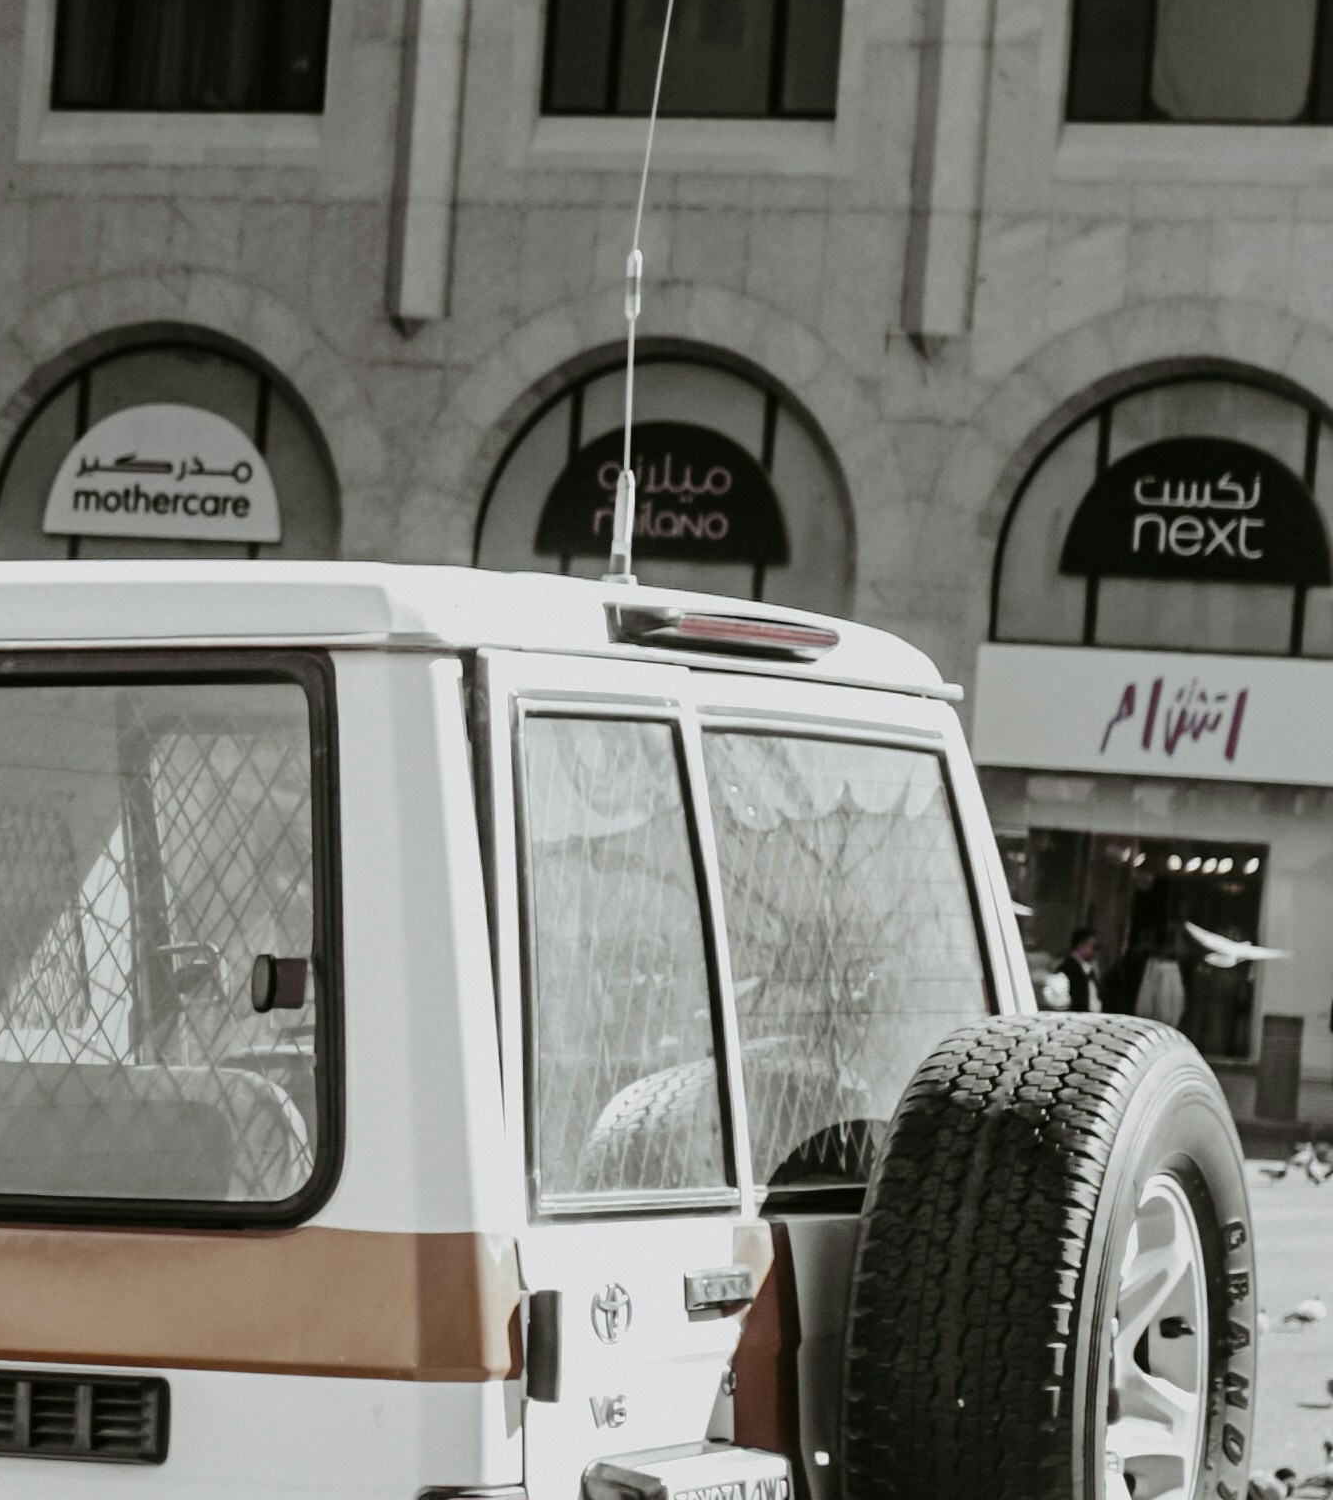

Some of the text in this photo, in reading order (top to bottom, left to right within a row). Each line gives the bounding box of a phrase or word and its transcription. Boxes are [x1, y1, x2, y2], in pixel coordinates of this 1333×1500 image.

[73, 483, 251, 519] mothercare
[1134, 471, 1261, 510] نكست
[1133, 512, 1265, 560] next
[589, 1394, 628, 1430] V6
